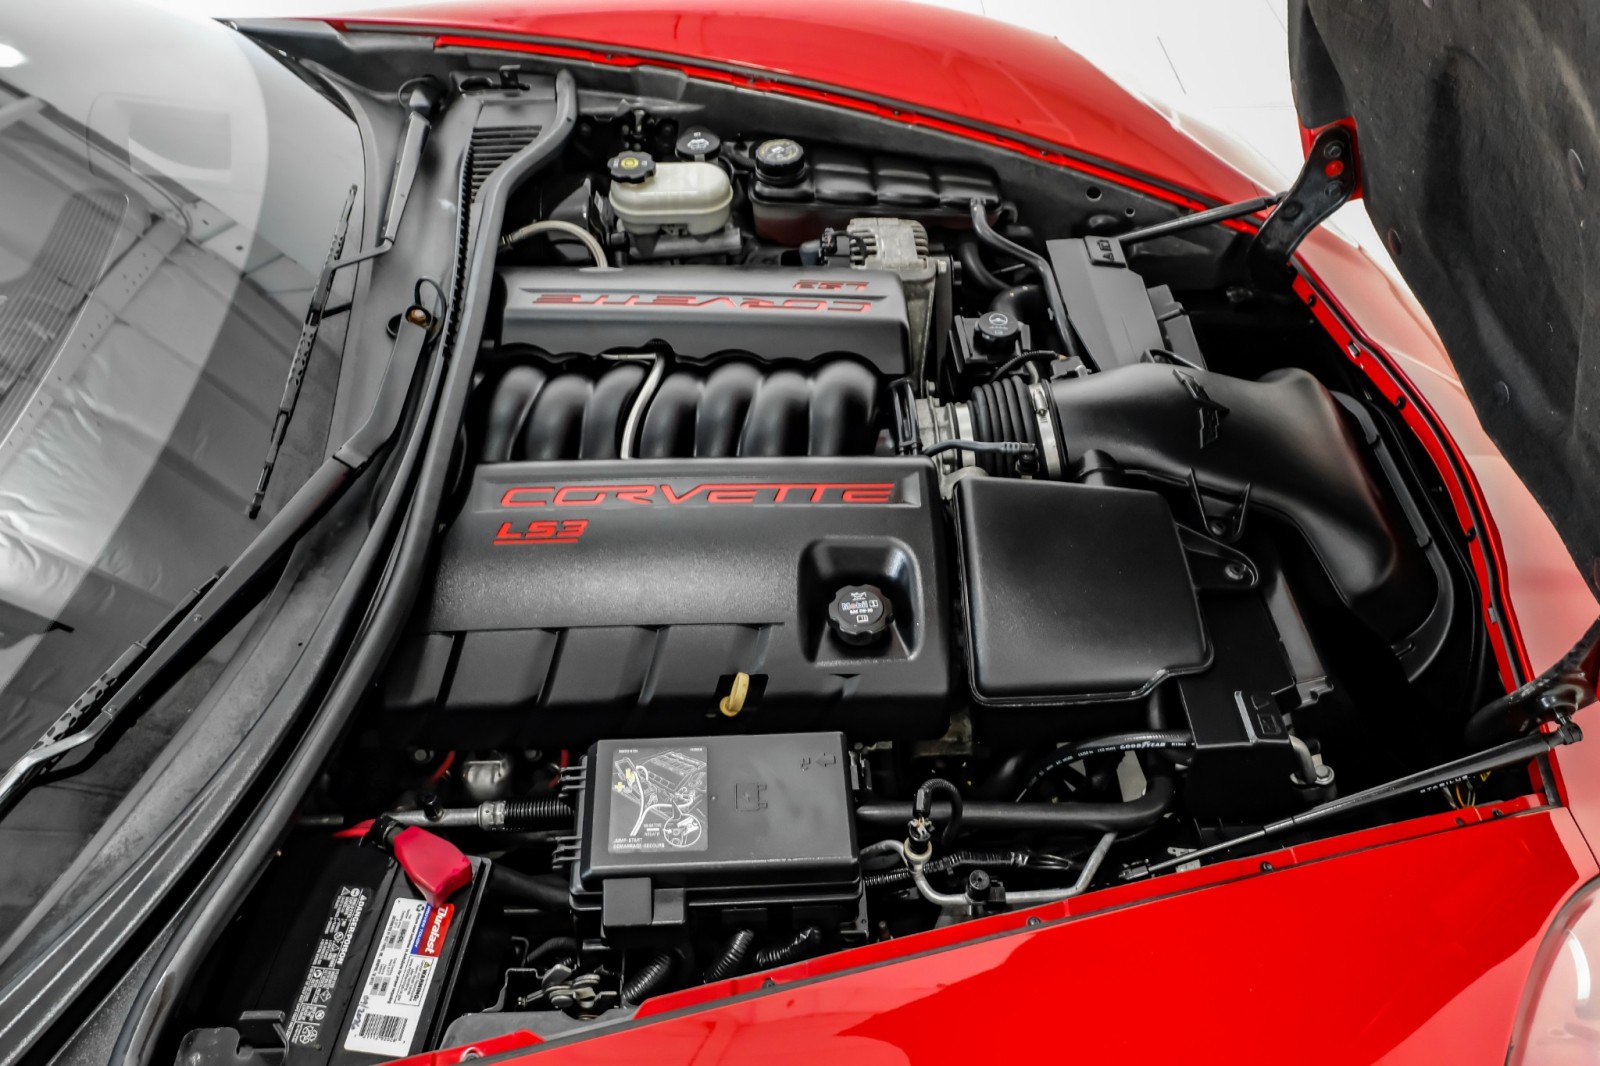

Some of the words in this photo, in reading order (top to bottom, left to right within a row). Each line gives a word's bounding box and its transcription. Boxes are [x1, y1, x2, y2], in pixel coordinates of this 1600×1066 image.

[532, 294, 872, 313] CORVETTE
[500, 482, 895, 508] CORVETTE
[494, 519, 590, 541] LS3
[842, 600, 868, 610] Mobil
[1120, 740, 1166, 750] GOODYEAR
[1420, 775, 1468, 794] STABILUS
[424, 905, 448, 953] Duralast
